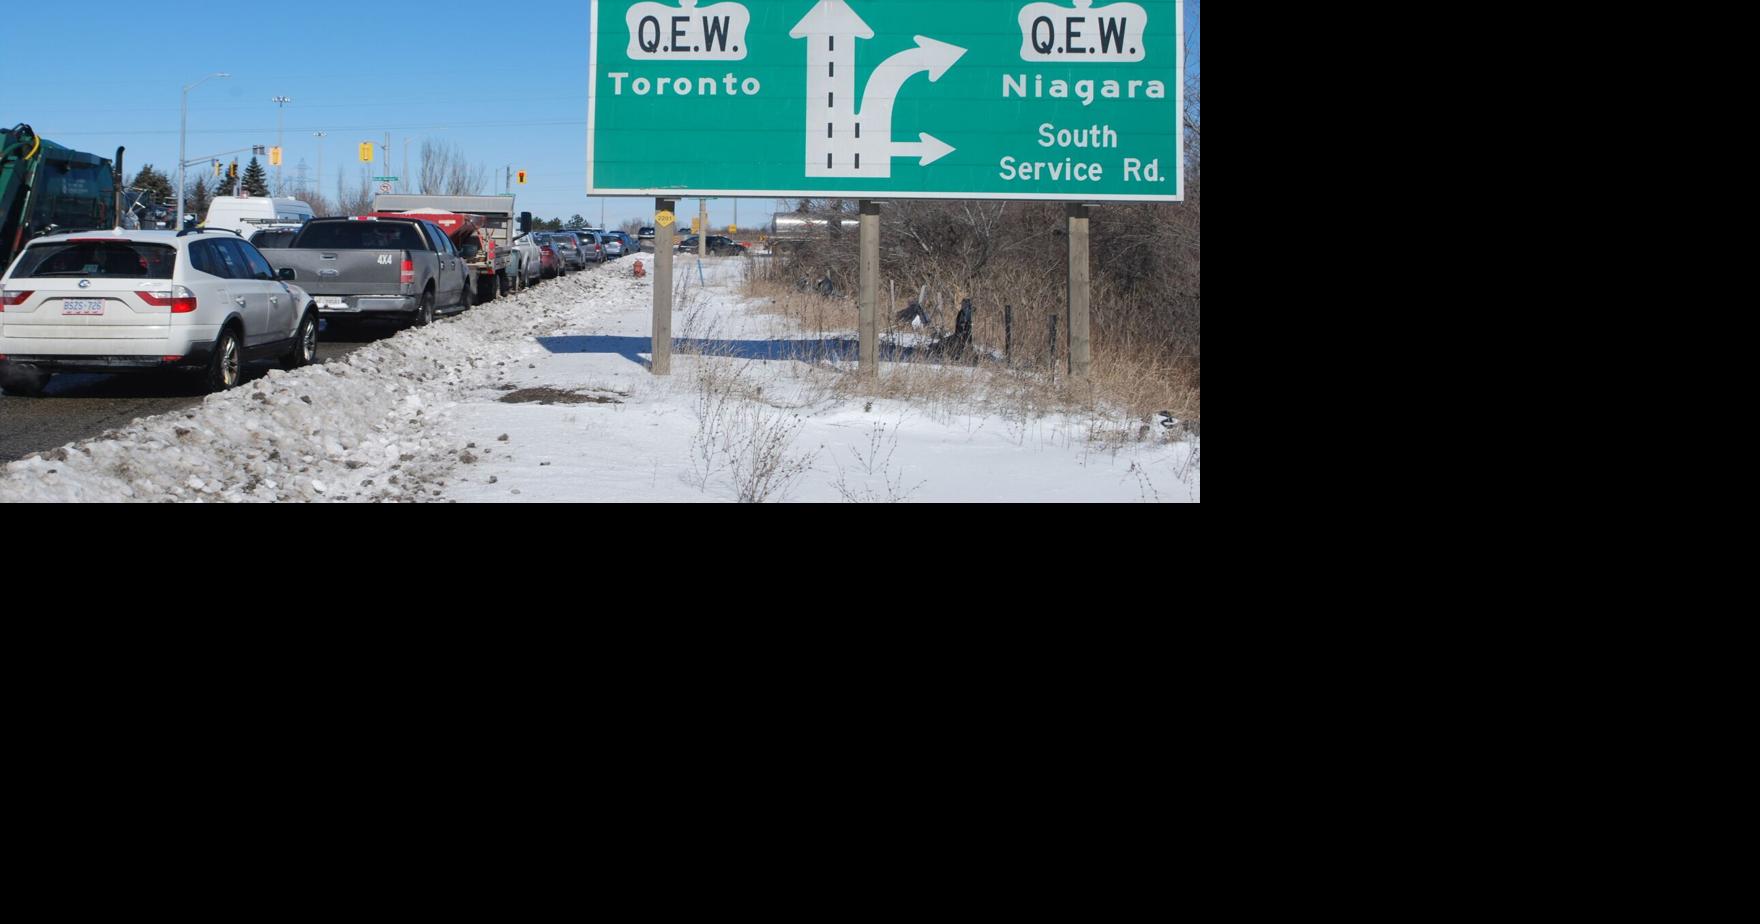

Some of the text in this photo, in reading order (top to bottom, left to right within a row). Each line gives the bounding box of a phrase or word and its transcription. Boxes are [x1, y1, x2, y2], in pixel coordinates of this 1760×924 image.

[638, 15, 739, 54] Q.E.W.
[1031, 15, 1136, 55] Q.E.W.
[608, 72, 761, 96] Toronto
[1002, 74, 1165, 106] Niagara
[1038, 122, 1118, 148] South
[999, 155, 1165, 182] Service Rd.
